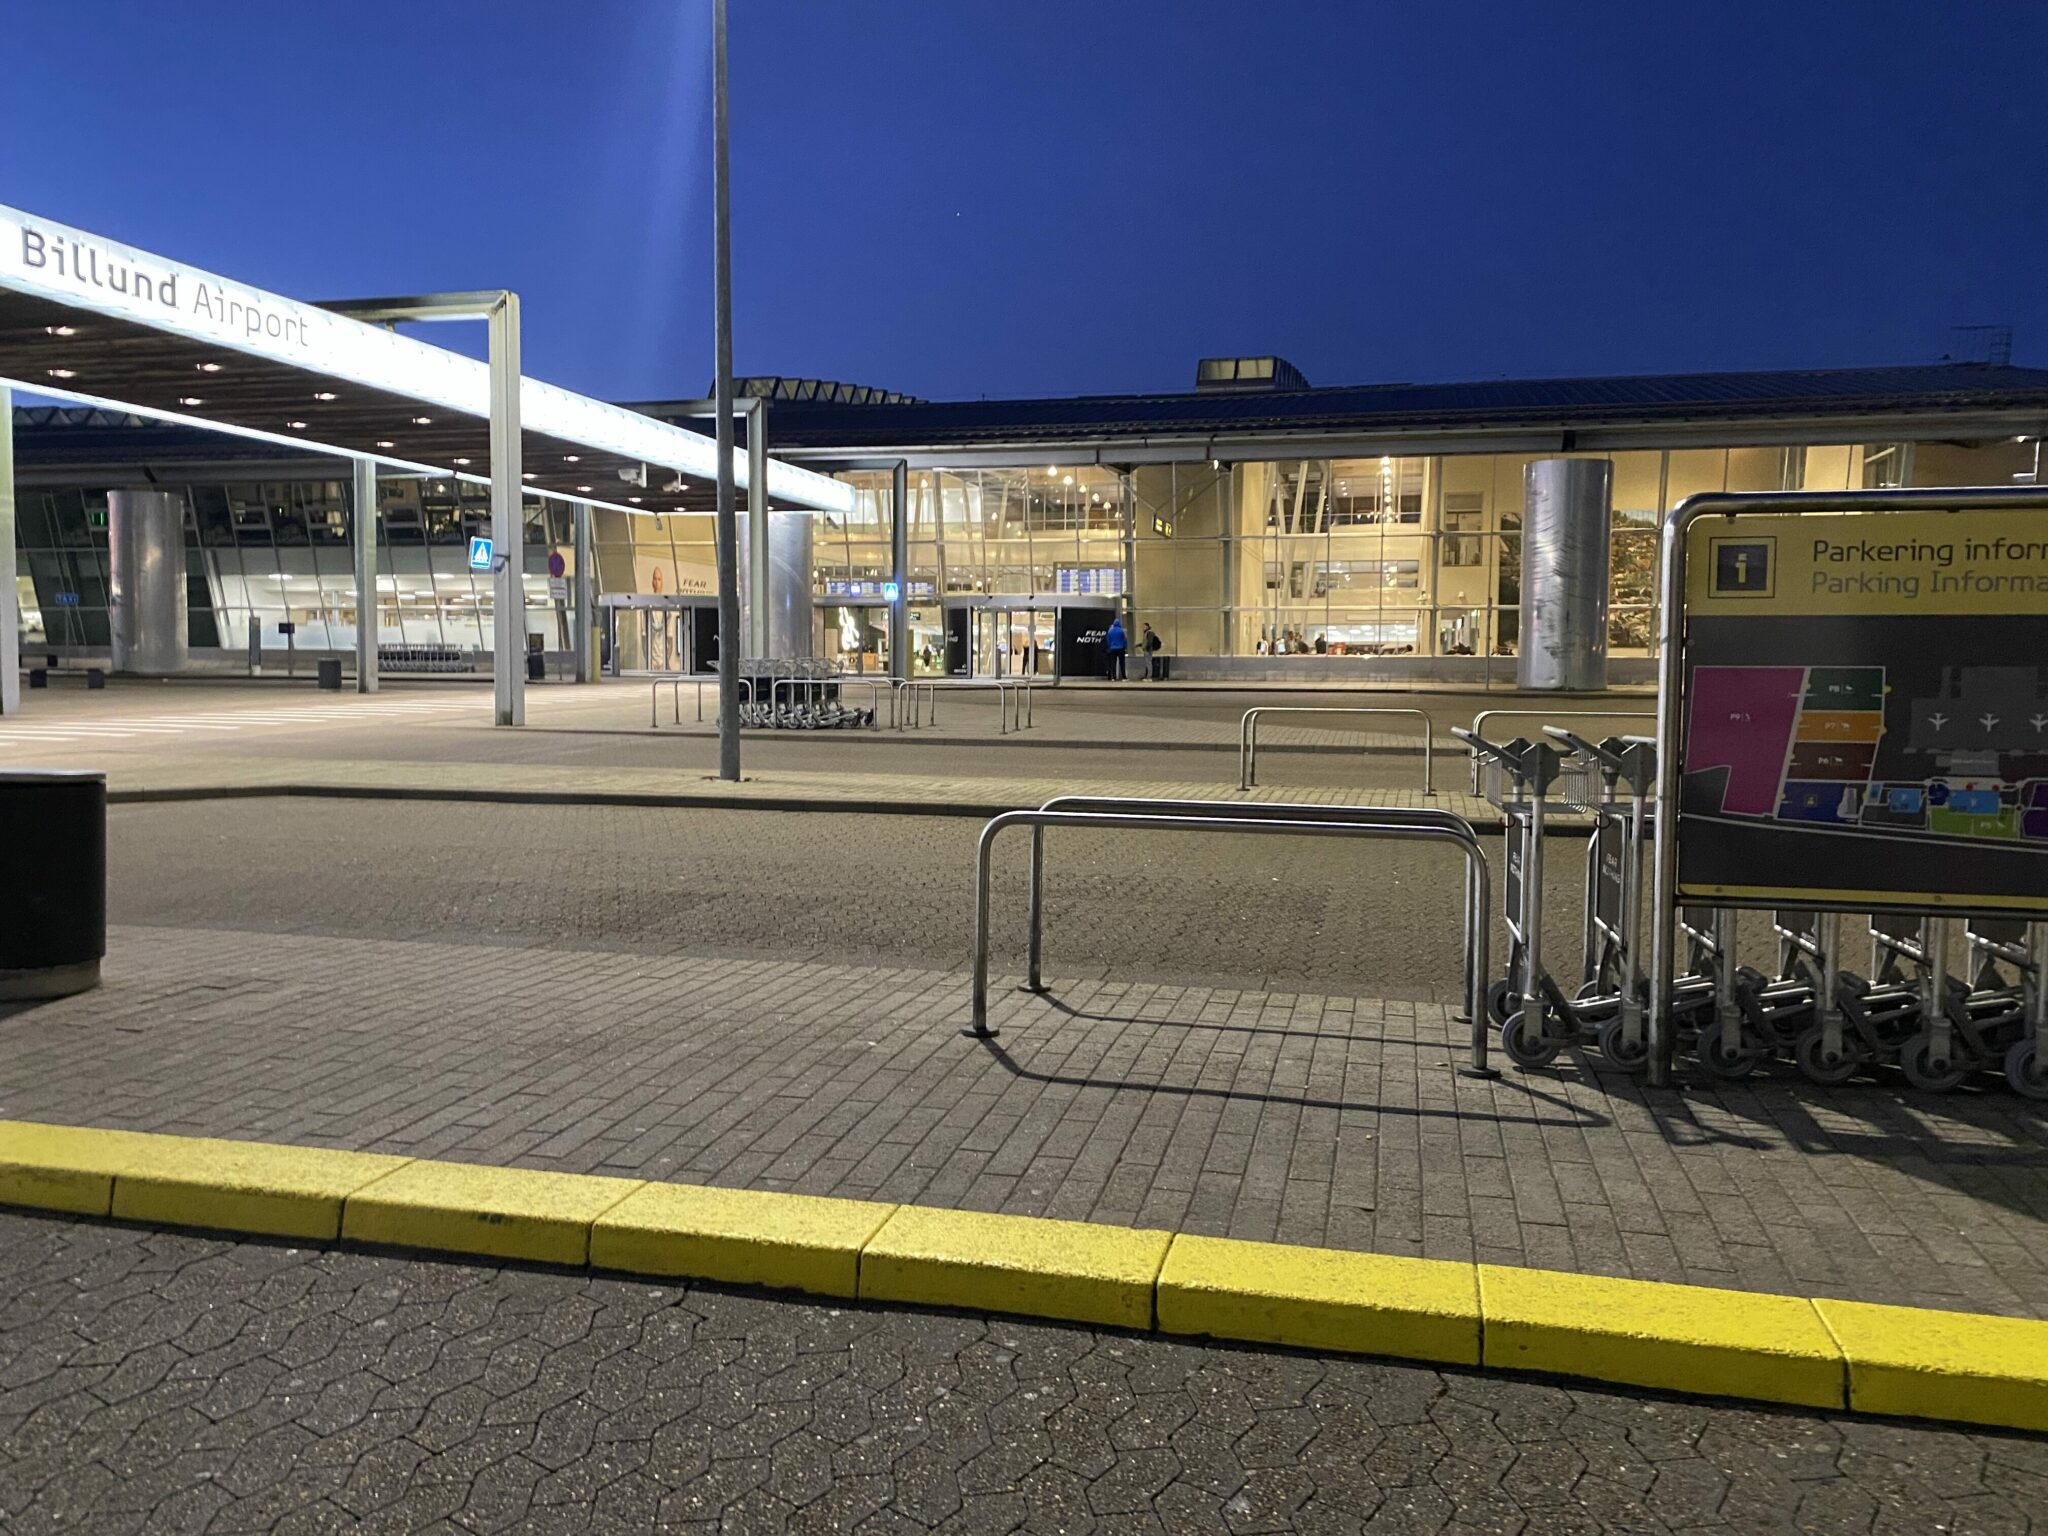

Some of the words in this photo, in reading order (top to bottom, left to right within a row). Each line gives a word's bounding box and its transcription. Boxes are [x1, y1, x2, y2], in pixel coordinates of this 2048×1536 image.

[21, 226, 179, 309] Billund
[193, 283, 309, 347] Airport
[1813, 538, 1953, 567] Parkering
[1966, 537, 2048, 561] infor
[683, 578, 707, 589] FEAR
[1812, 571, 1920, 599] Parking
